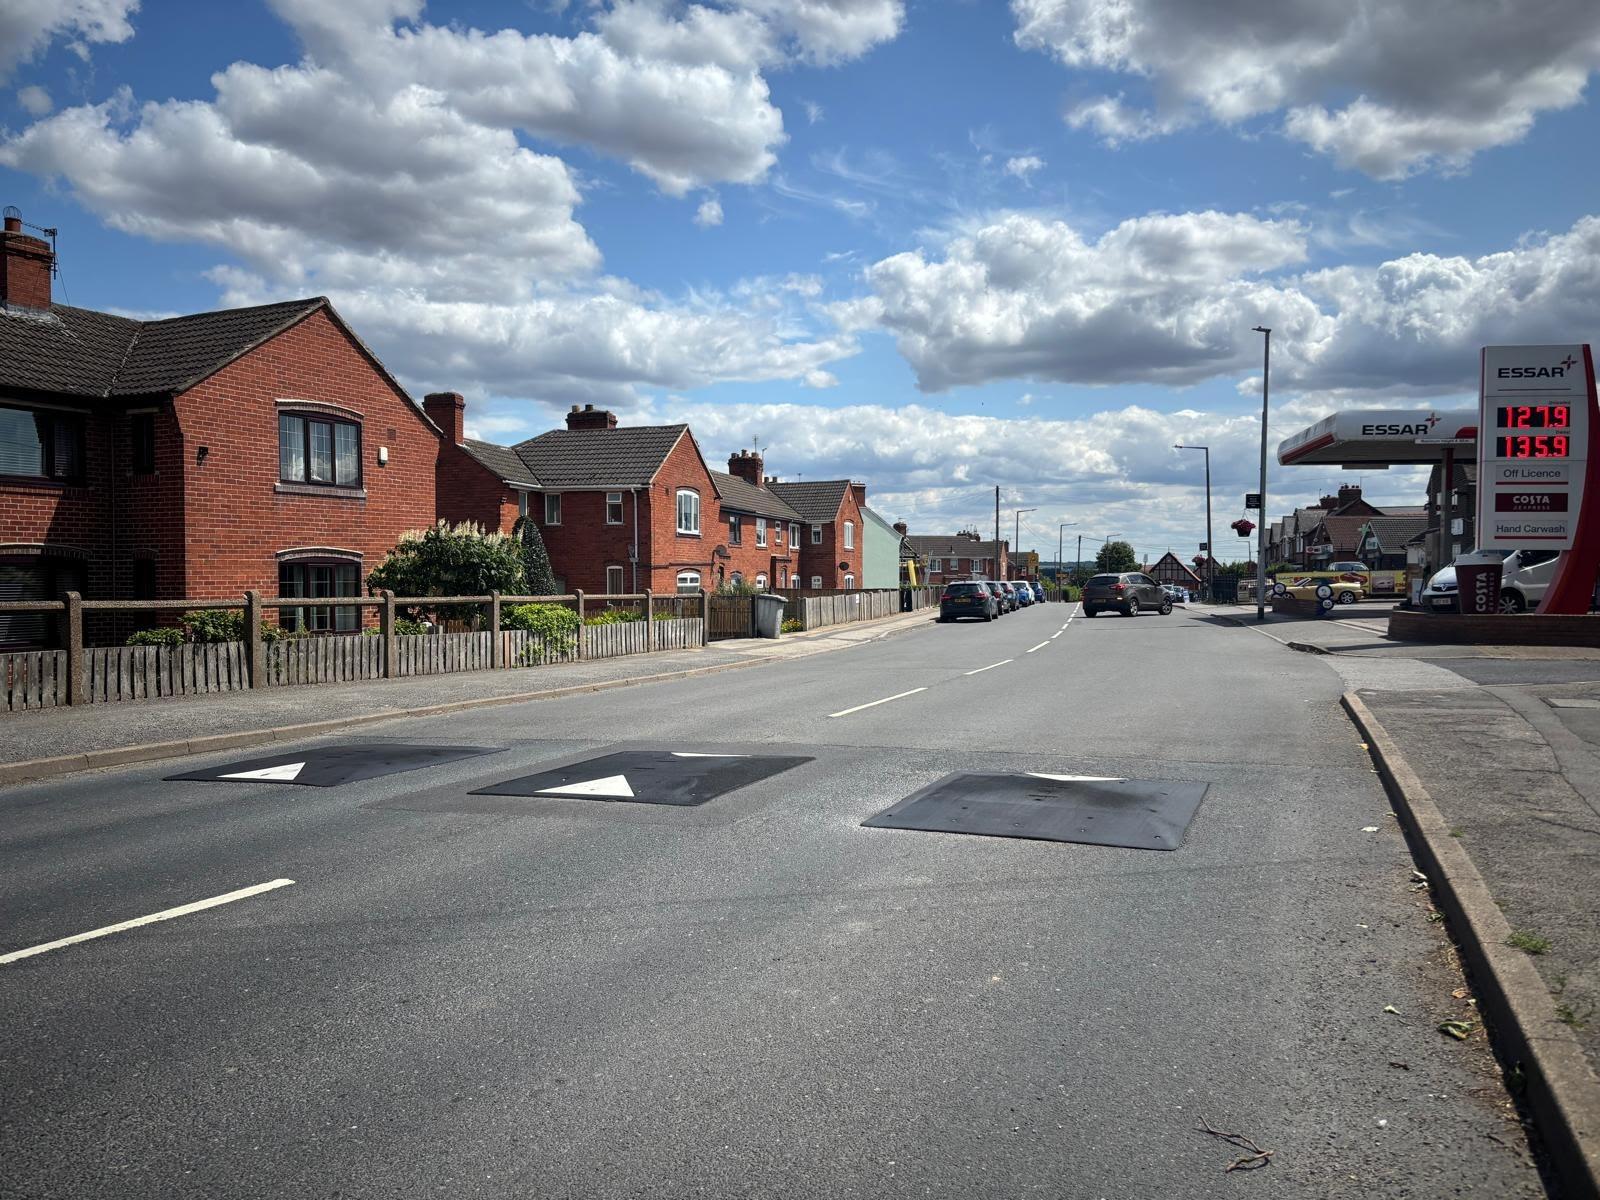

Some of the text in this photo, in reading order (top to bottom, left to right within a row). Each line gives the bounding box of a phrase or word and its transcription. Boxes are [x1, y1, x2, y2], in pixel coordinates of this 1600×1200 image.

[1497, 366, 1564, 378] ESSAR
[1362, 424, 1428, 435] ESSAR
[1503, 469, 1561, 478] Off Licence
[1512, 495, 1550, 504] COSTA
[1496, 524, 1565, 533] Hand Carwash
[1475, 572, 1488, 612] COSTA
